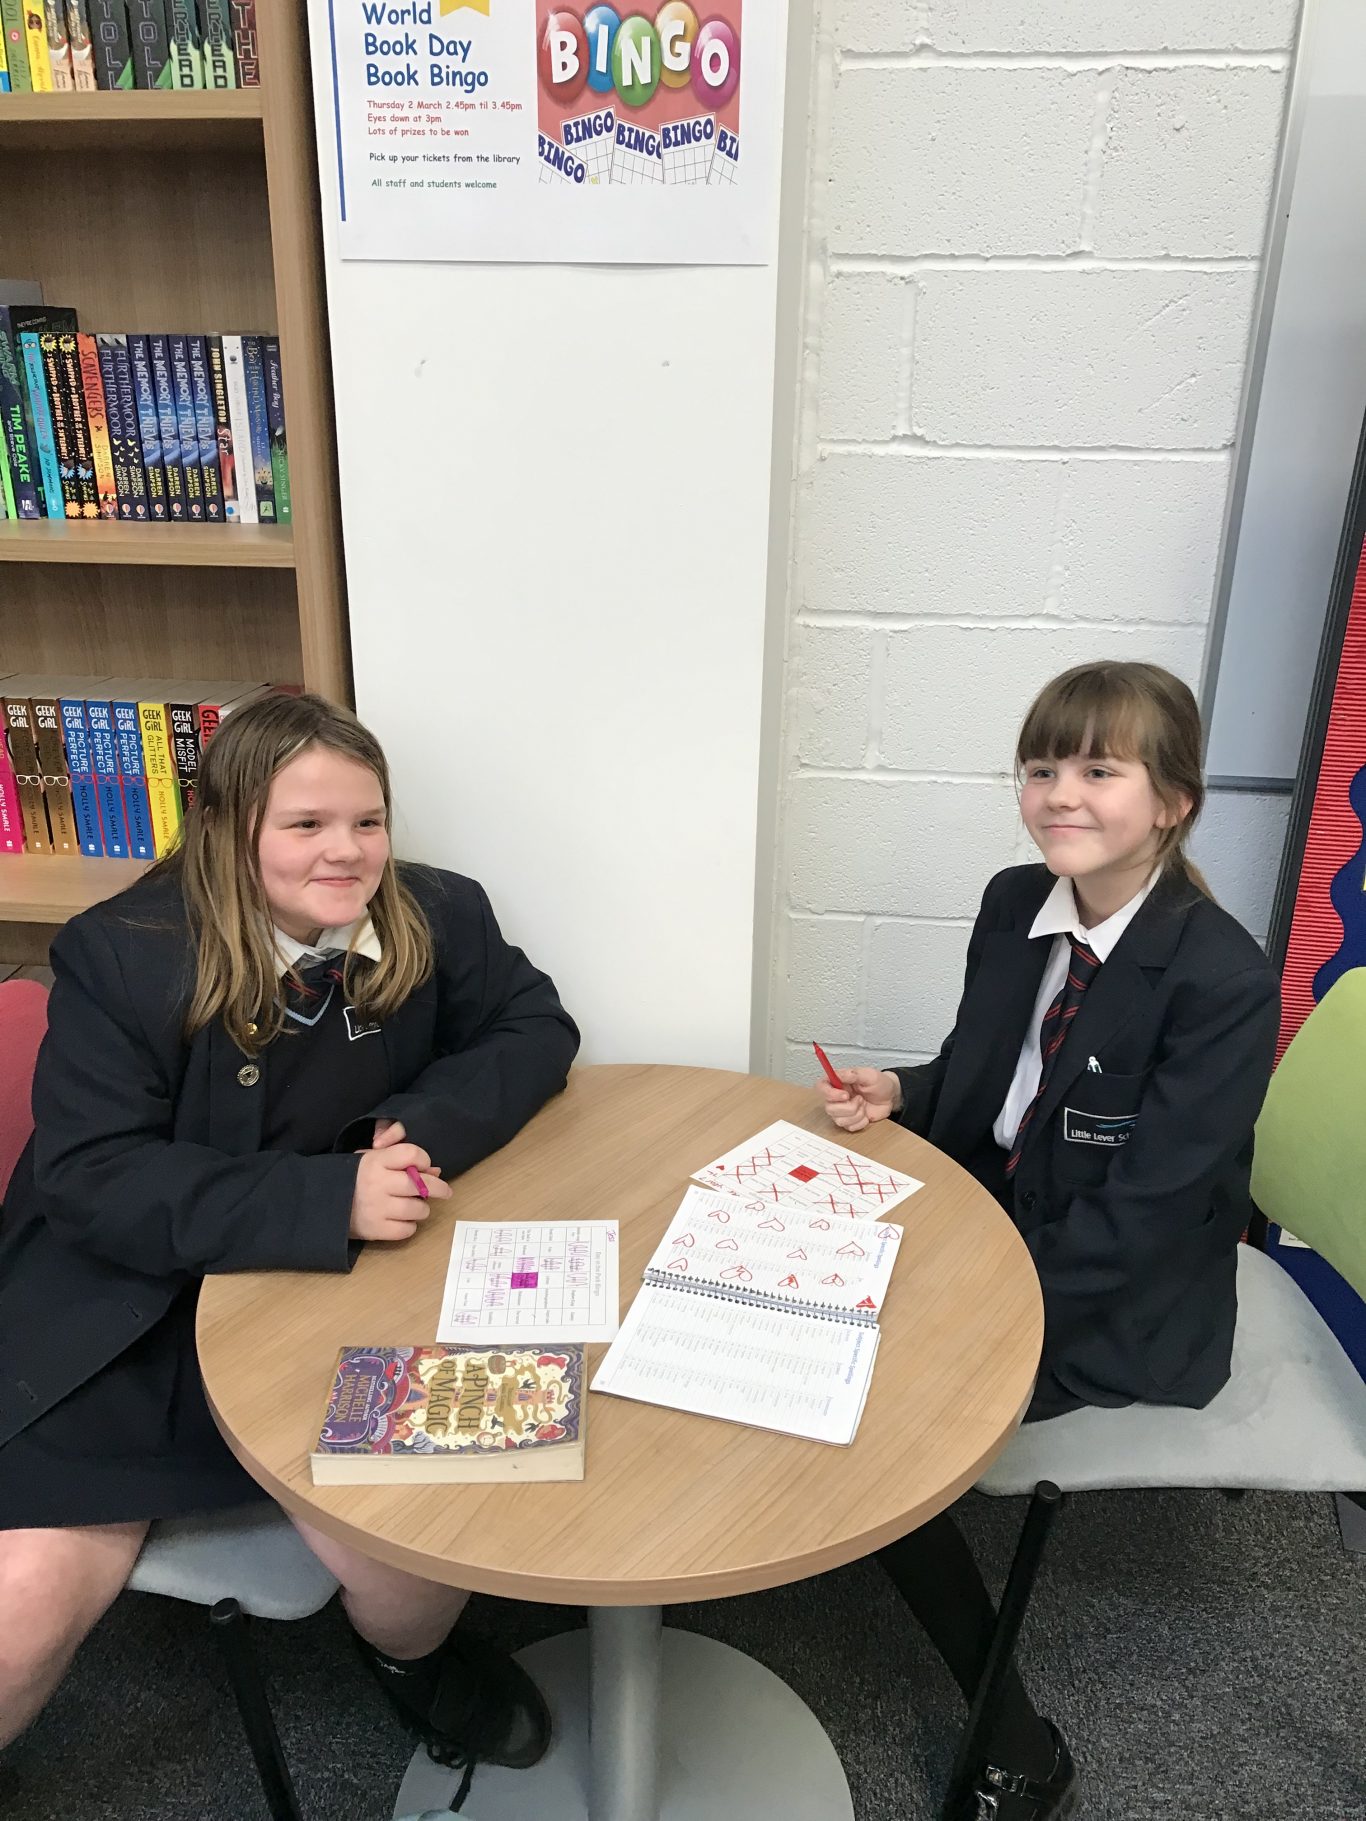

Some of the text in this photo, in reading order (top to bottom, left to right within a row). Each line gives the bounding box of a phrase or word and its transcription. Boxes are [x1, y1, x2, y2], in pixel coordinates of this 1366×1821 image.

[362, 1, 432, 25] World
[233, 1, 260, 88] THE
[364, 32, 472, 63] Book Day
[549, 19, 730, 87] BINGO
[366, 63, 489, 93] Book Bingo
[367, 100, 523, 112] Thursday 2 March 2.45pm til 3.45pm
[367, 113, 442, 124] Eyes down at 3pm
[368, 127, 386, 136] Lots
[389, 127, 398, 136] of
[401, 128, 426, 138] prizes
[430, 128, 438, 136] to
[441, 128, 450, 136] be
[563, 110, 615, 146] BINGO
[661, 118, 714, 149] BINGO
[369, 152, 521, 165] Pick up your tickets from the library
[538, 133, 585, 183] BINGO
[371, 179, 497, 188] All staff and students welcome
[65, 357, 77, 386] SWAPPED
[81, 350, 104, 418] SCAVENGERS
[211, 347, 227, 423] JOHN SINGLETON
[270, 360, 281, 408] Feather Boy
[46, 356, 58, 386] SWAPPED
[52, 393, 64, 421] BROTHER
[100, 350, 122, 438] FURTHERMOOR
[115, 350, 137, 438] FURTHERMOOR
[133, 340, 158, 450] THE MEMORY THIEVES
[153, 340, 175, 450] THE MEMORY THIEVES
[173, 341, 195, 451] THE MEMORY THIEVES
[190, 340, 212, 450] THE MEMORY THIEVES
[70, 393, 82, 421] BROTHER
[10, 405, 31, 483] TIM PEAKE
[217, 428, 231, 455] Star
[114, 465, 124, 497] SIMPSON
[121, 466, 130, 494] DARREN
[129, 465, 139, 498] SIMPSON
[135, 468, 145, 496] DARREN
[148, 466, 157, 498] SIMPSON
[154, 468, 163, 496] DARREN
[166, 465, 175, 497] SIMPSON
[172, 467, 181, 495] DARREN
[186, 466, 195, 498] SIMPSON
[192, 468, 201, 496] DARREN
[203, 466, 212, 498] SIMPSON
[209, 467, 218, 496] DARREN
[7, 704, 27, 716] GEEK
[10, 716, 29, 728] GIRL
[35, 705, 56, 717] GEEK
[38, 717, 58, 729] GIRL
[63, 706, 82, 717] GEEK
[65, 717, 84, 729] GIRL
[89, 707, 108, 719] GEEK
[91, 719, 110, 730] GIRL
[115, 708, 135, 719] GEEK
[118, 719, 136, 731] GIRL
[142, 709, 161, 720] GEEK
[144, 720, 163, 732] GIRL
[171, 710, 191, 722] GEEK
[201, 709, 219, 743] GEE
[174, 722, 193, 734] GIRL
[68, 730, 80, 773] PERFECT
[77, 731, 88, 773] PICTURE
[93, 731, 106, 774] PERFECT
[103, 732, 115, 774] PICTURE
[120, 733, 132, 775] PERFECT
[129, 734, 140, 775] PICTURE
[147, 735, 159, 774] GLITTERS
[158, 754, 167, 774] THAT
[175, 738, 188, 773] MISFIT
[185, 738, 197, 773] MODEL
[1, 809, 11, 832] SMALE
[58, 812, 67, 835] SMALE
[80, 785, 94, 839] HOLLY SMALE
[105, 786, 119, 840] HOLLY SMALE
[131, 787, 144, 842] HOLLY SMALE
[158, 790, 170, 840] HOLLY SMALE
[1071, 1129, 1092, 1140] Little
[1093, 1132, 1116, 1143] Lever
[333, 1373, 355, 1424] HARRISON
[349, 1373, 369, 1423] MICHELLE
[426, 1360, 457, 1436] OF MAGIC
[458, 1362, 488, 1430] A PINCH
